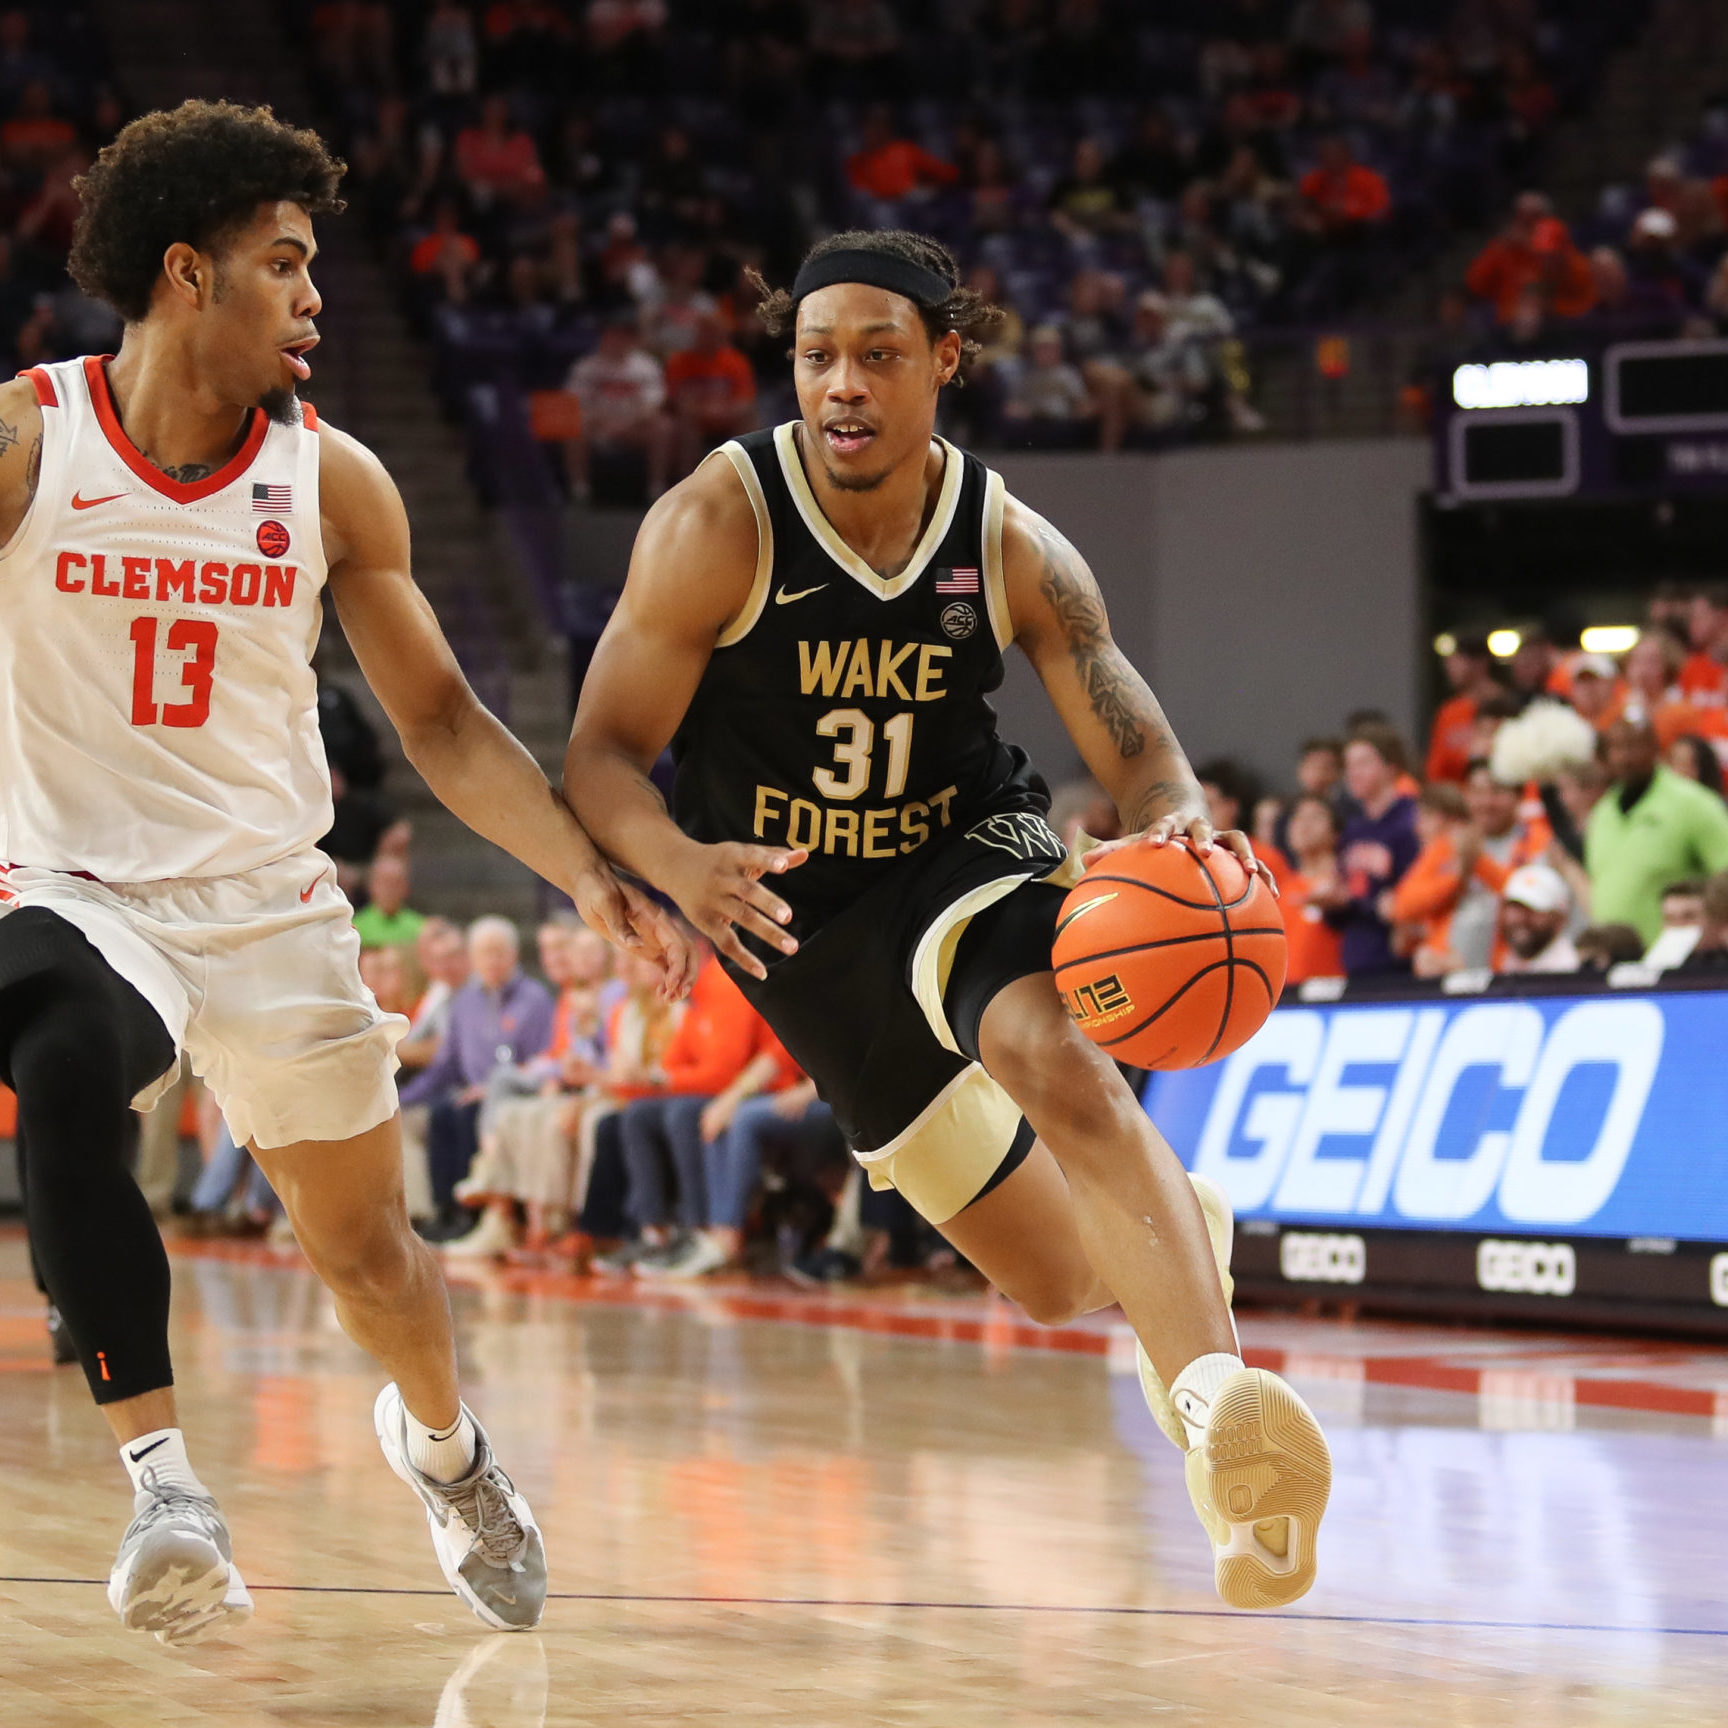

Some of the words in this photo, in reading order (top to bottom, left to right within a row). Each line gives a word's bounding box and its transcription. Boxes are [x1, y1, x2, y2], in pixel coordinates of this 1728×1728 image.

[55, 551, 298, 607] CLEMSON
[129, 616, 219, 728] 13
[798, 637, 953, 702] WAKE
[812, 708, 914, 801] 31
[753, 784, 958, 859] FOREST
[1190, 998, 1665, 1226] GEICO
[1476, 1238, 1577, 1297] GEICO
